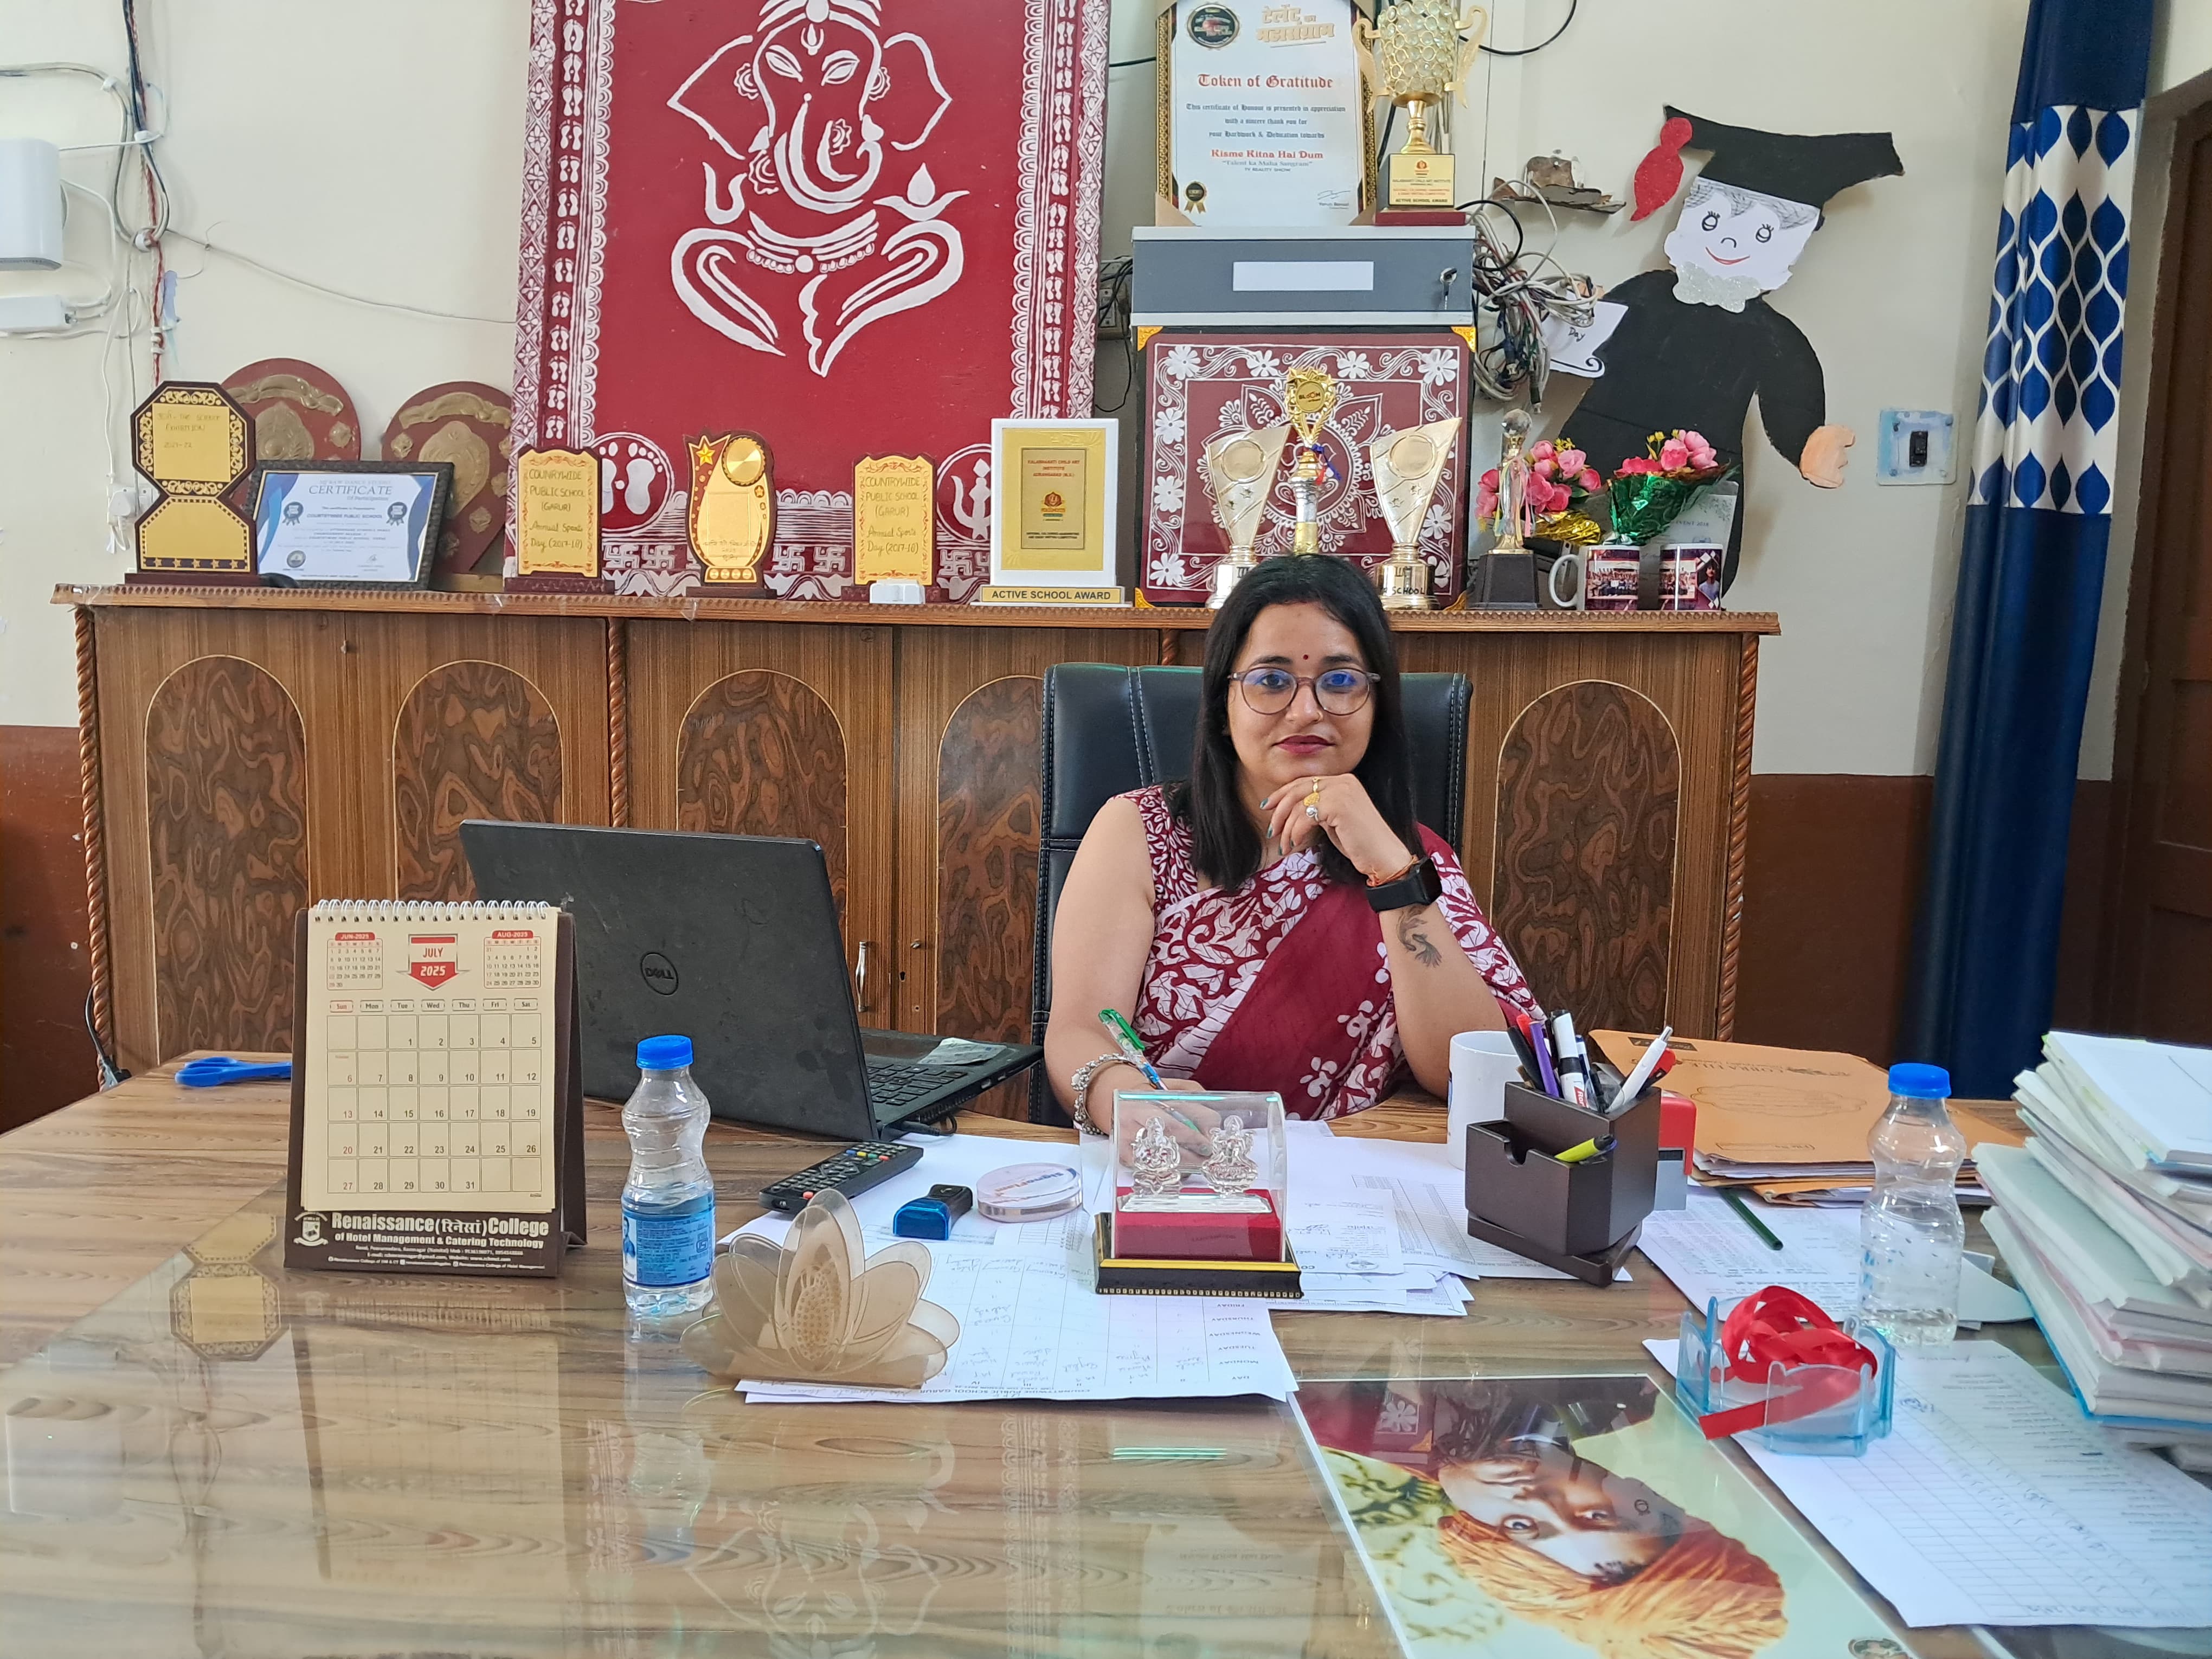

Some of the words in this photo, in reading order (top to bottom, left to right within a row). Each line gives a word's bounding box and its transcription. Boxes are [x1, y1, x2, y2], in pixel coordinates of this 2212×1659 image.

[1198, 74, 1242, 87] Token
[1247, 75, 1261, 87] of
[1266, 75, 1334, 88] Gratitude
[1211, 149, 1244, 158] Kisme
[1246, 150, 1275, 158] Kitna
[1278, 150, 1296, 158] Hai
[1299, 150, 1323, 159] Dum
[1568, 327, 1585, 342] Day
[865, 477, 921, 487] COUNTRYWIDE
[309, 485, 393, 495] CERTIFICATE
[530, 485, 559, 497] PUBLIC
[560, 487, 586, 497] SCHOOL
[866, 491, 892, 502] PUBLIC
[895, 492, 920, 501] SCHOOL
[867, 525, 894, 538] Annual
[531, 538, 548, 554] Day
[867, 540, 885, 557] Day
[992, 590, 1028, 599] ACTIVE
[1030, 591, 1072, 599] SCHOOL
[1073, 591, 1111, 600] AWARD
[423, 947, 443, 958] JULY
[420, 966, 446, 976] 2025
[439, 1038, 443, 1046] 2
[470, 1037, 474, 1046] 3
[531, 1037, 537, 1045] 5
[347, 1075, 352, 1083] 6
[378, 1074, 383, 1082] 7
[408, 1073, 413, 1082] 8
[439, 1074, 443, 1082] 9
[465, 1073, 474, 1082] 10
[496, 1073, 504, 1081] 11
[526, 1072, 536, 1081] 12
[344, 1110, 352, 1118] 13
[374, 1110, 383, 1118] 14
[404, 1110, 414, 1118] 15
[435, 1110, 444, 1118] 16
[465, 1109, 474, 1117] 17
[496, 1109, 505, 1117] 18
[526, 1109, 536, 1117] 19
[343, 1146, 353, 1154] 20
[374, 1146, 383, 1154] 21
[404, 1146, 414, 1154] 22
[435, 1146, 445, 1154] 23
[465, 1145, 475, 1154] 24
[496, 1145, 506, 1153] 25
[526, 1144, 536, 1153] 26
[343, 1182, 353, 1190] 27
[374, 1182, 383, 1190] 28
[404, 1181, 414, 1189] 29
[435, 1181, 445, 1189] 30
[466, 1181, 474, 1189] 31
[332, 1212, 434, 1232] Renaissance
[488, 1217, 549, 1238] College
[335, 1232, 345, 1242] of
[346, 1232, 371, 1242] Hotel
[372, 1233, 435, 1245] Management
[436, 1236, 444, 1245] &
[445, 1236, 487, 1248] Catering
[488, 1238, 544, 1249] Technology
